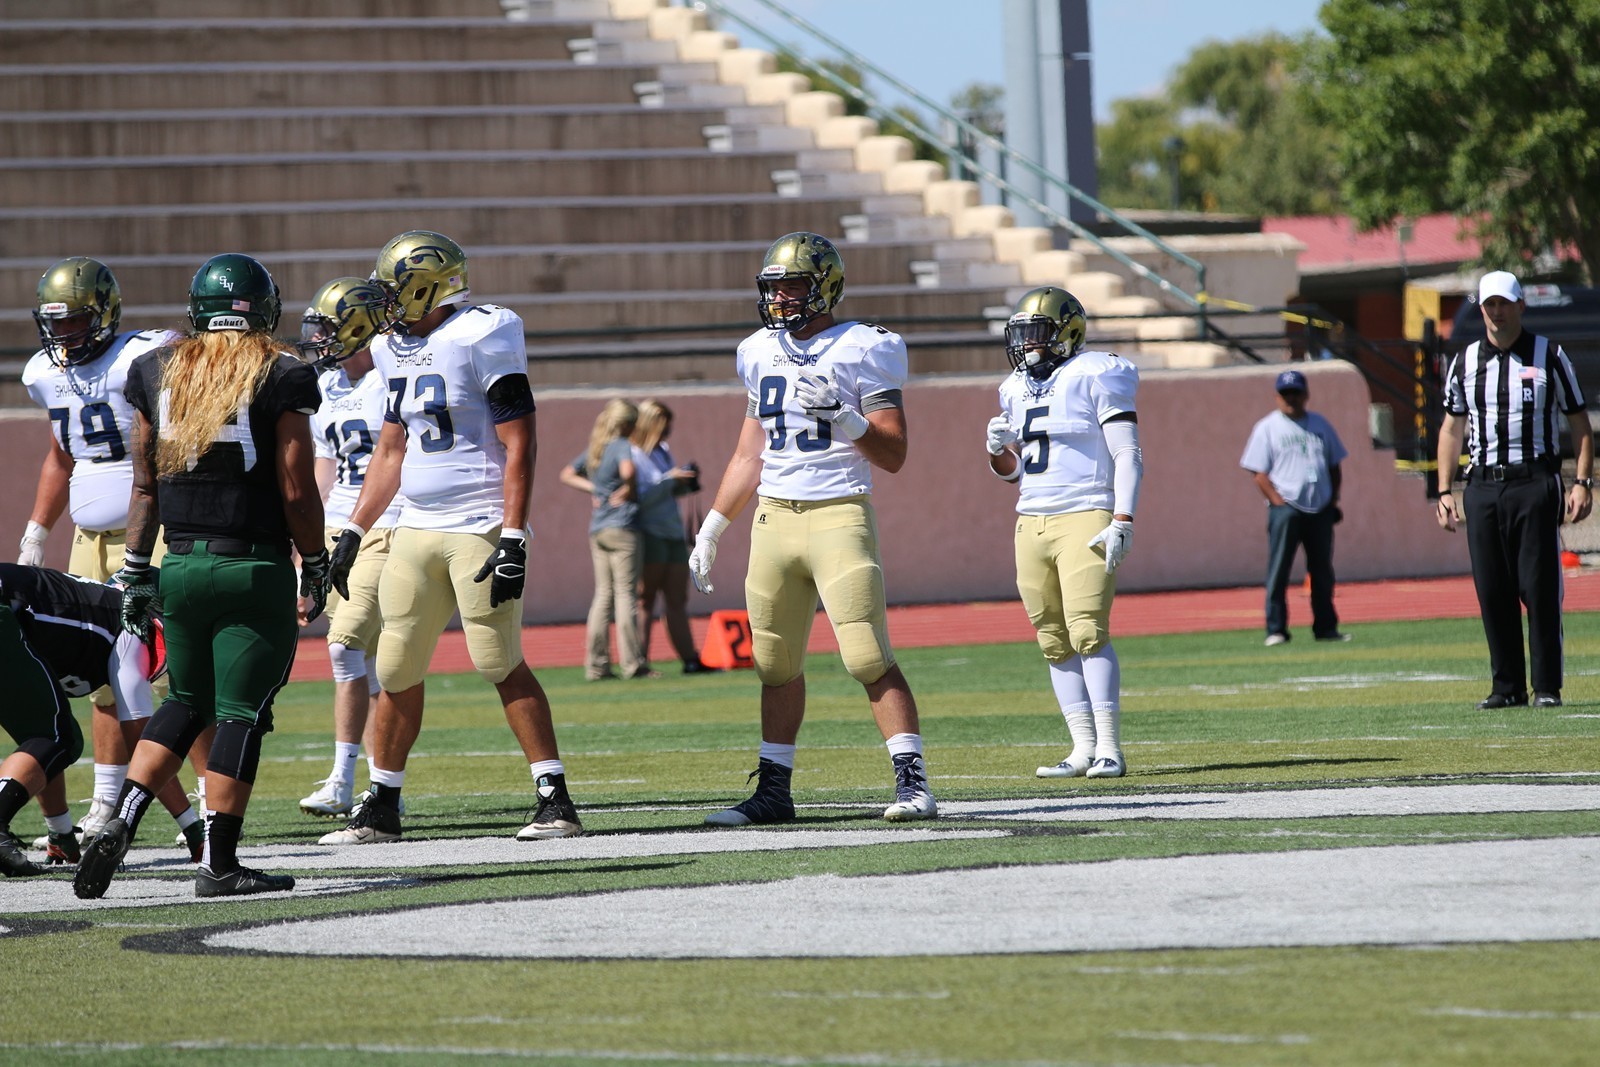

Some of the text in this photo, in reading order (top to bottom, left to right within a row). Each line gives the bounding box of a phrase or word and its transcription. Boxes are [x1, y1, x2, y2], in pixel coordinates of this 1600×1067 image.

[212, 318, 244, 327] schutt
[396, 353, 433, 368] SKYHAWKS
[772, 354, 818, 367] SKYHAWKS
[55, 382, 93, 398] SKYHAWKS
[1523, 387, 1534, 402] R
[330, 398, 363, 412] SKYHAWKS
[388, 373, 457, 454] 73
[50, 401, 126, 464] 79
[1022, 405, 1050, 475] 5
[325, 418, 374, 486] 12
